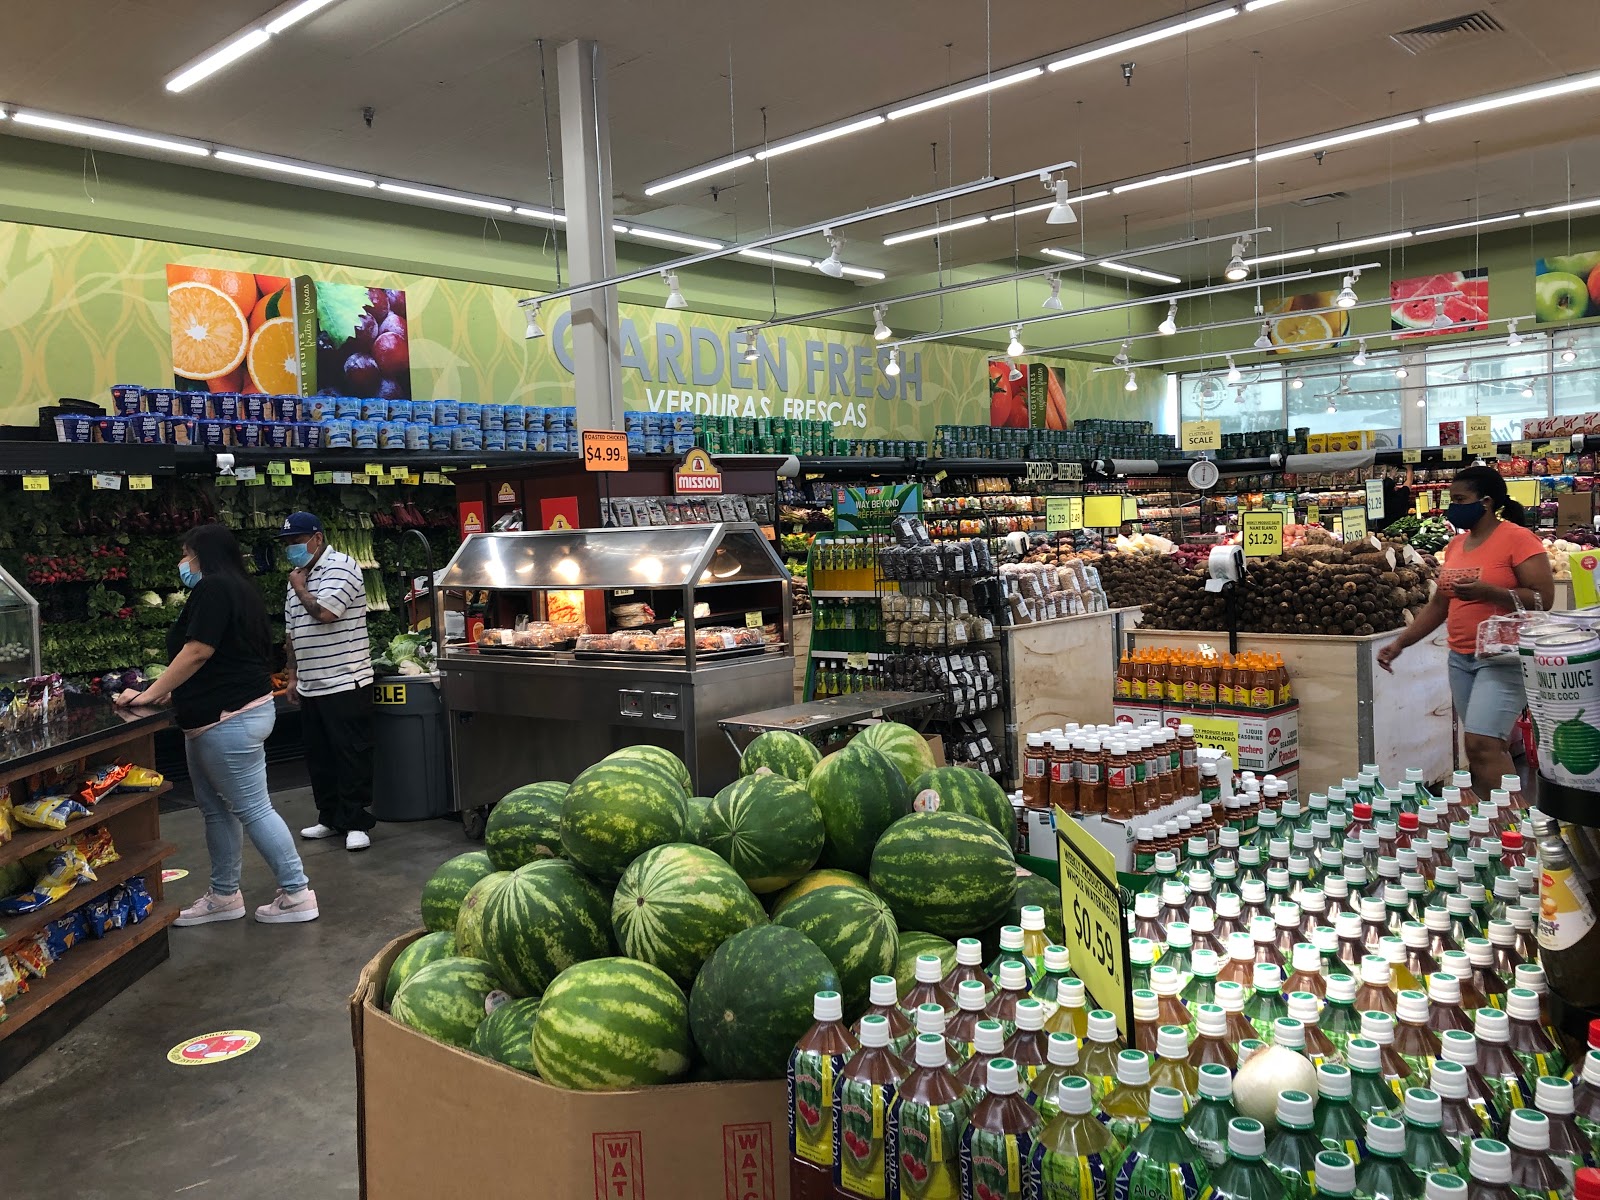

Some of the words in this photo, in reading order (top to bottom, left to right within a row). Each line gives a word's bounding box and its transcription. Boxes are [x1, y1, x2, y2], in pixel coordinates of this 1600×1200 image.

[806, 340, 922, 401] FRESH
[646, 388, 772, 418] VERDURAS
[783, 398, 867, 428] FRESCAS
[586, 445, 620, 463] $4.99
[1027, 462, 1053, 480] CHOPPED
[678, 476, 720, 489] MISSION
[856, 500, 870, 508] WAY
[871, 499, 900, 508] BEYOND
[1048, 514, 1066, 524] $1.29
[1248, 532, 1274, 546] $1.29
[1561, 669, 1594, 690] JUICE
[1558, 692, 1580, 700] COCO
[1238, 744, 1264, 755] anchero
[1064, 848, 1081, 873] WEEKLY
[1081, 866, 1104, 894] PRODUCE
[1102, 884, 1118, 906] SALES
[1066, 866, 1084, 894] WHOLE
[1074, 894, 1114, 977] $0.59
[832, 1090, 842, 1166] Aloevine
[607, 1142, 628, 1197] WAT
